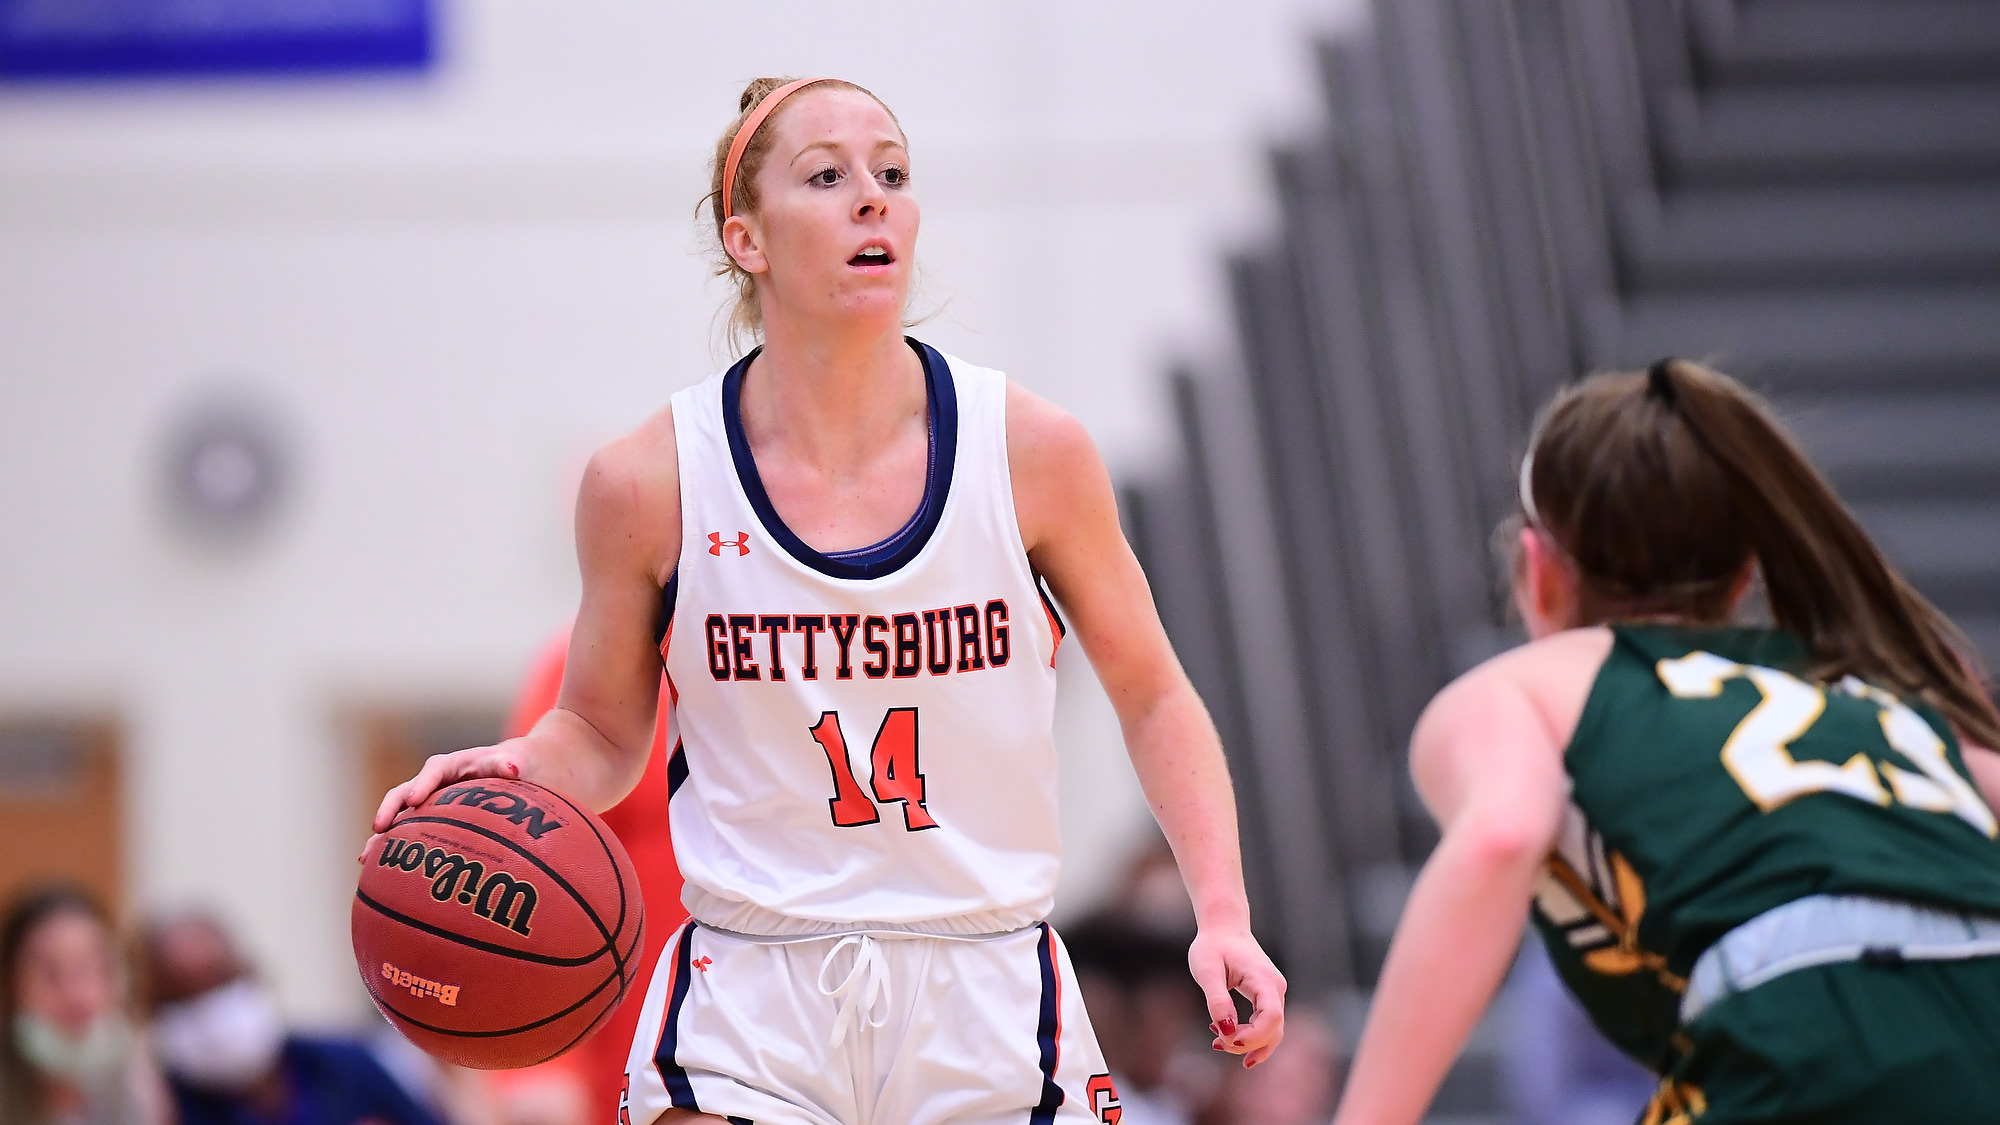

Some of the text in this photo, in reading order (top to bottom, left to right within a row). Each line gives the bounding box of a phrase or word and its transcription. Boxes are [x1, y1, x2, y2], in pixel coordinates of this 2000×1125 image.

[704, 598, 1011, 682] GETTYSBURG
[808, 706, 941, 832] 14
[434, 786, 563, 840] NCAA
[378, 837, 538, 938] Wilson
[381, 962, 460, 1007] Bullets
